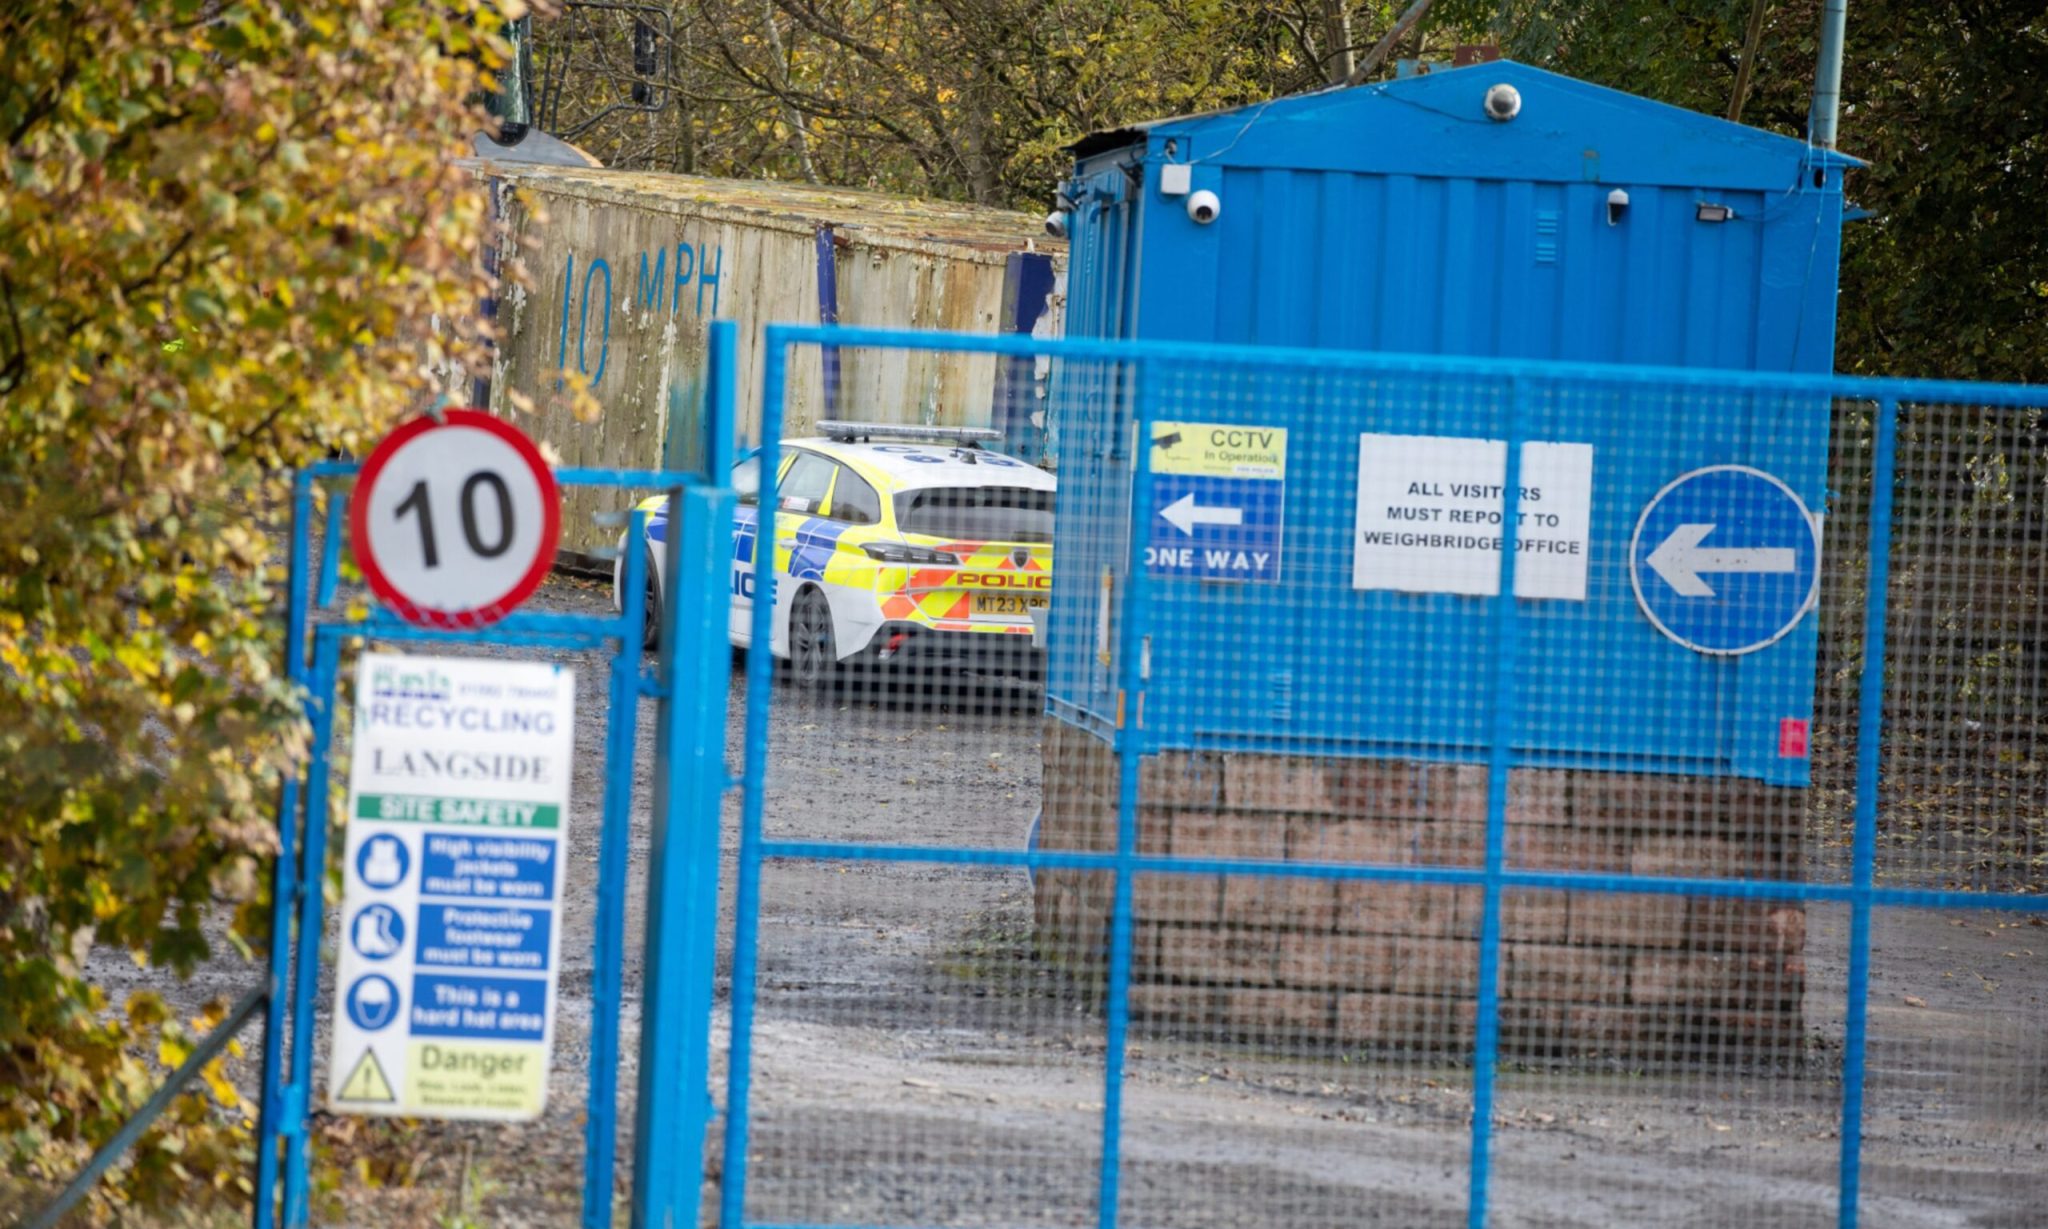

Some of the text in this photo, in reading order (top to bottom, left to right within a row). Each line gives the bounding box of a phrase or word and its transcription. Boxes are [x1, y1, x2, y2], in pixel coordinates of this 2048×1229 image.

[557, 241, 722, 393] 10 MPH
[1211, 429, 1273, 449] CCTV
[1204, 451, 1278, 465] In Operation
[1408, 481, 1541, 501] ALL VISITRS
[394, 468, 515, 569] 10
[1387, 506, 1560, 528] MUST REPOT TO
[1364, 531, 1503, 551] WEIGHBRIDGE
[1204, 550, 1270, 571] WAY
[976, 595, 1015, 613] MT23
[371, 703, 555, 735] RECYCLING
[373, 748, 552, 783] LANGSIDE
[379, 796, 539, 826] SITE SAFETY
[426, 877, 471, 893] must
[474, 877, 497, 895] be
[423, 947, 469, 963] must
[471, 948, 495, 965] be
[434, 984, 520, 1008] This is a
[412, 1005, 544, 1031] hard hat area
[421, 1044, 527, 1078] Danger
